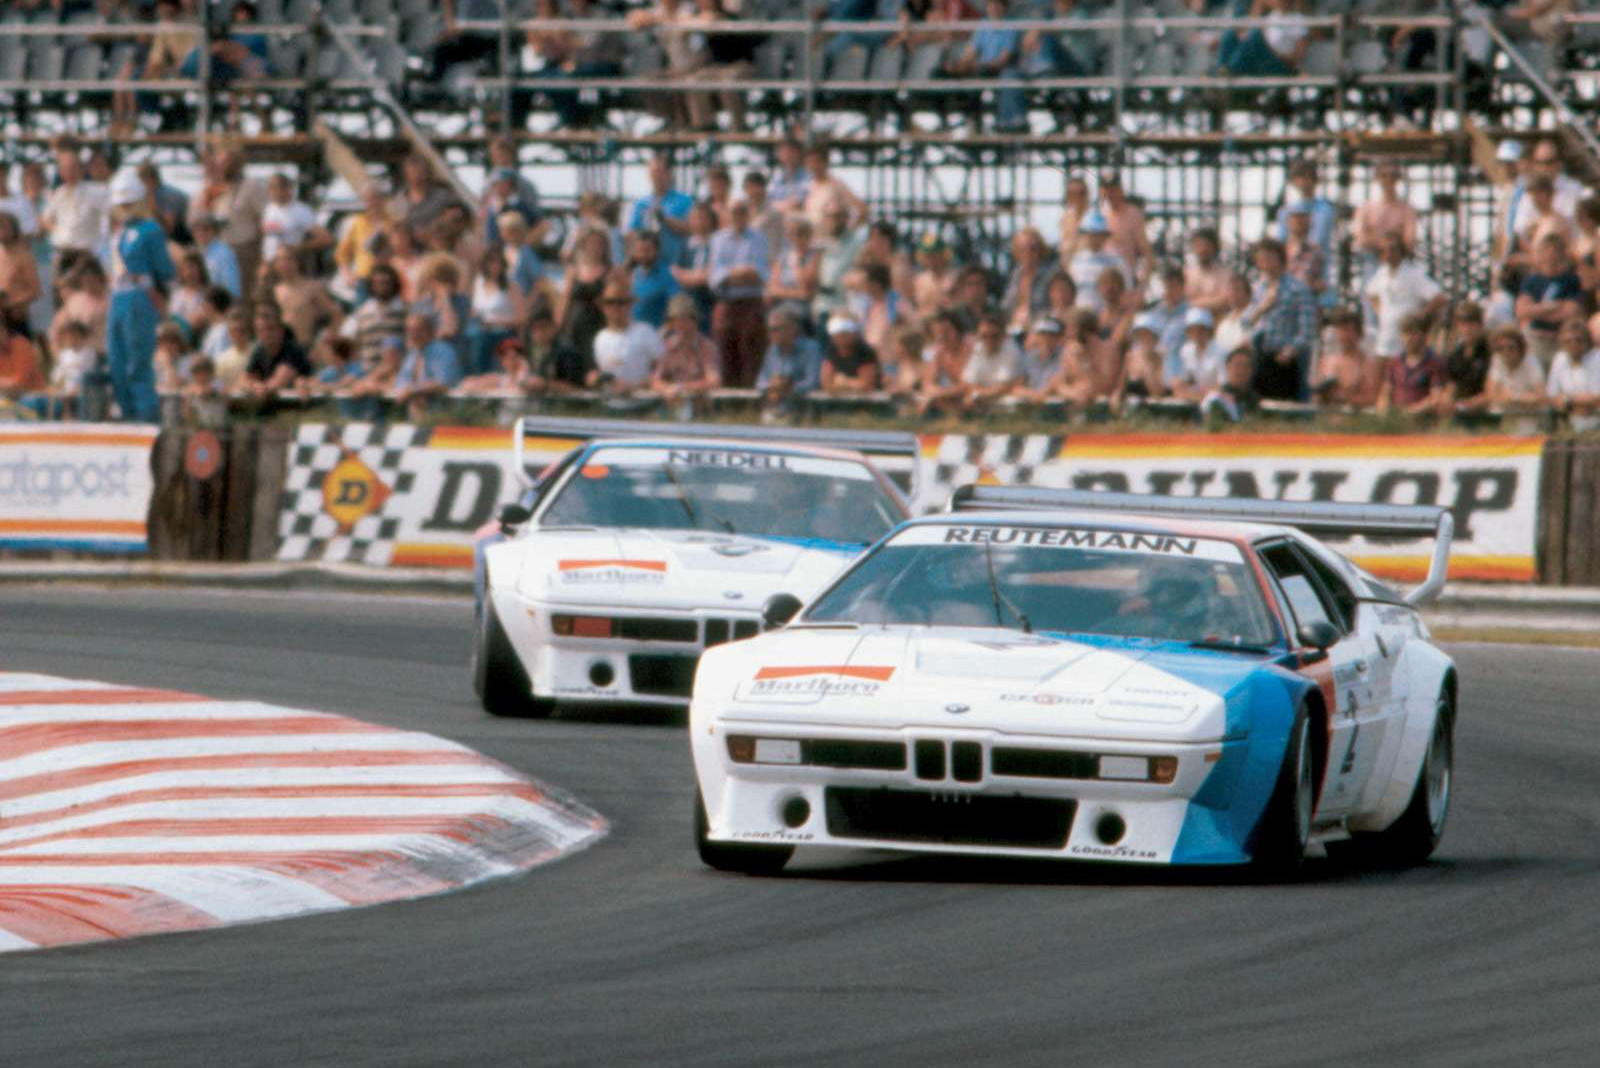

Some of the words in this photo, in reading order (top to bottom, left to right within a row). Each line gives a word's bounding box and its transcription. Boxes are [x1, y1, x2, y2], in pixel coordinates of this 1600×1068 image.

[669, 450, 794, 472] NEEDELL
[334, 479, 369, 505] D
[1072, 469, 1519, 543] LOP
[943, 527, 1198, 555] REUTEMANN
[750, 678, 880, 696] Marlboro
